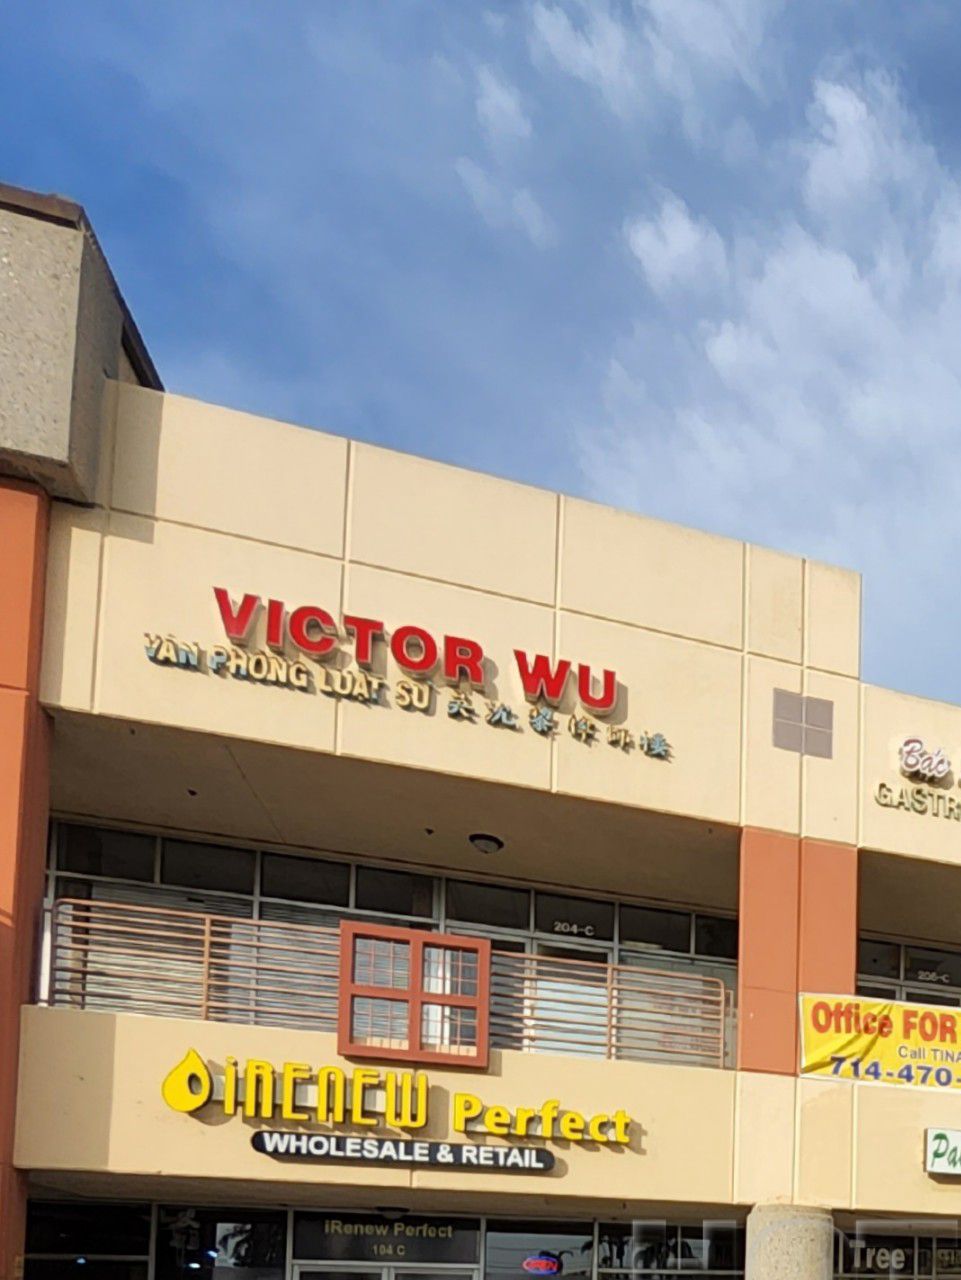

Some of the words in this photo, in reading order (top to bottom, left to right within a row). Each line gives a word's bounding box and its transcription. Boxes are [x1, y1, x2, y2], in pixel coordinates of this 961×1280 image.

[213, 586, 485, 686] VICTOR
[514, 649, 617, 711] WU
[553, 921, 595, 937] 204-C
[811, 1001, 894, 1038] Office
[902, 1009, 959, 1044] FOR
[898, 1045, 926, 1060] Call
[453, 1092, 631, 1144] Perfect
[262, 1131, 430, 1163] WHOLESALE
[436, 1145, 454, 1164] &
[461, 1146, 545, 1169] RETAIL
[324, 1219, 390, 1236] iRenew
[393, 1222, 453, 1239] Perfect
[849, 1239, 906, 1270] Tree
